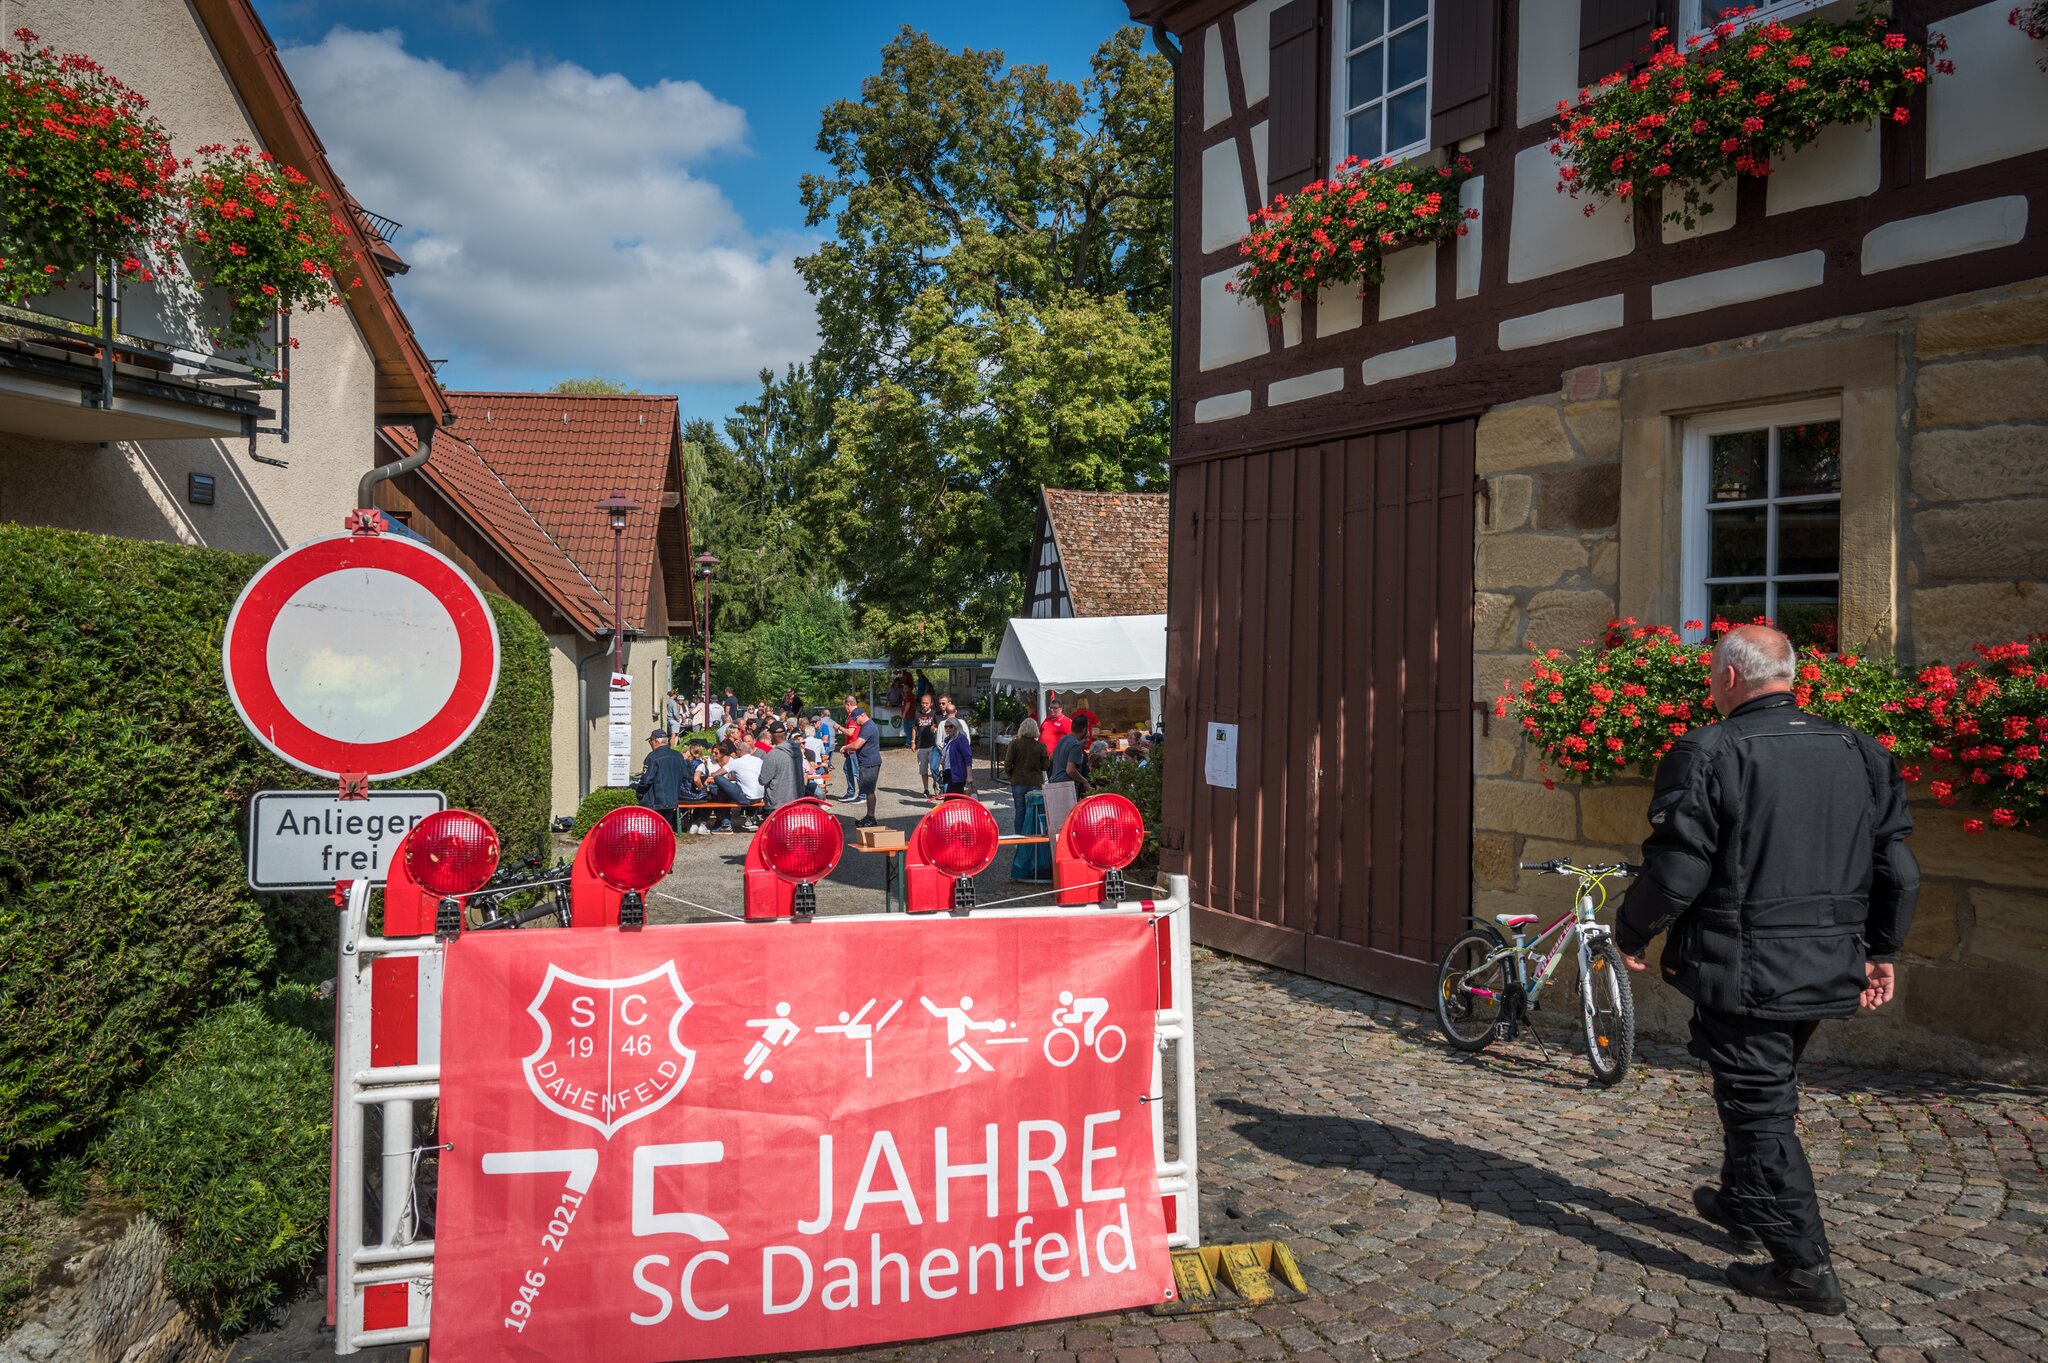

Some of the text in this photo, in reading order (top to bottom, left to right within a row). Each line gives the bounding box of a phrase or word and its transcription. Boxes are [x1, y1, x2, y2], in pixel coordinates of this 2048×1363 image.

[275, 808, 422, 842] Anlieger
[321, 843, 378, 871] frei
[569, 993, 649, 1028] S C
[566, 1034, 652, 1059] 19 46
[537, 1060, 678, 1113] DAHENFELD
[481, 1109, 1127, 1242] 75 JAHRE
[504, 1269, 546, 1334] 1946
[541, 1193, 584, 1253] 2021
[629, 1250, 731, 1327] SC
[761, 1202, 1138, 1317] Dahenfeld
